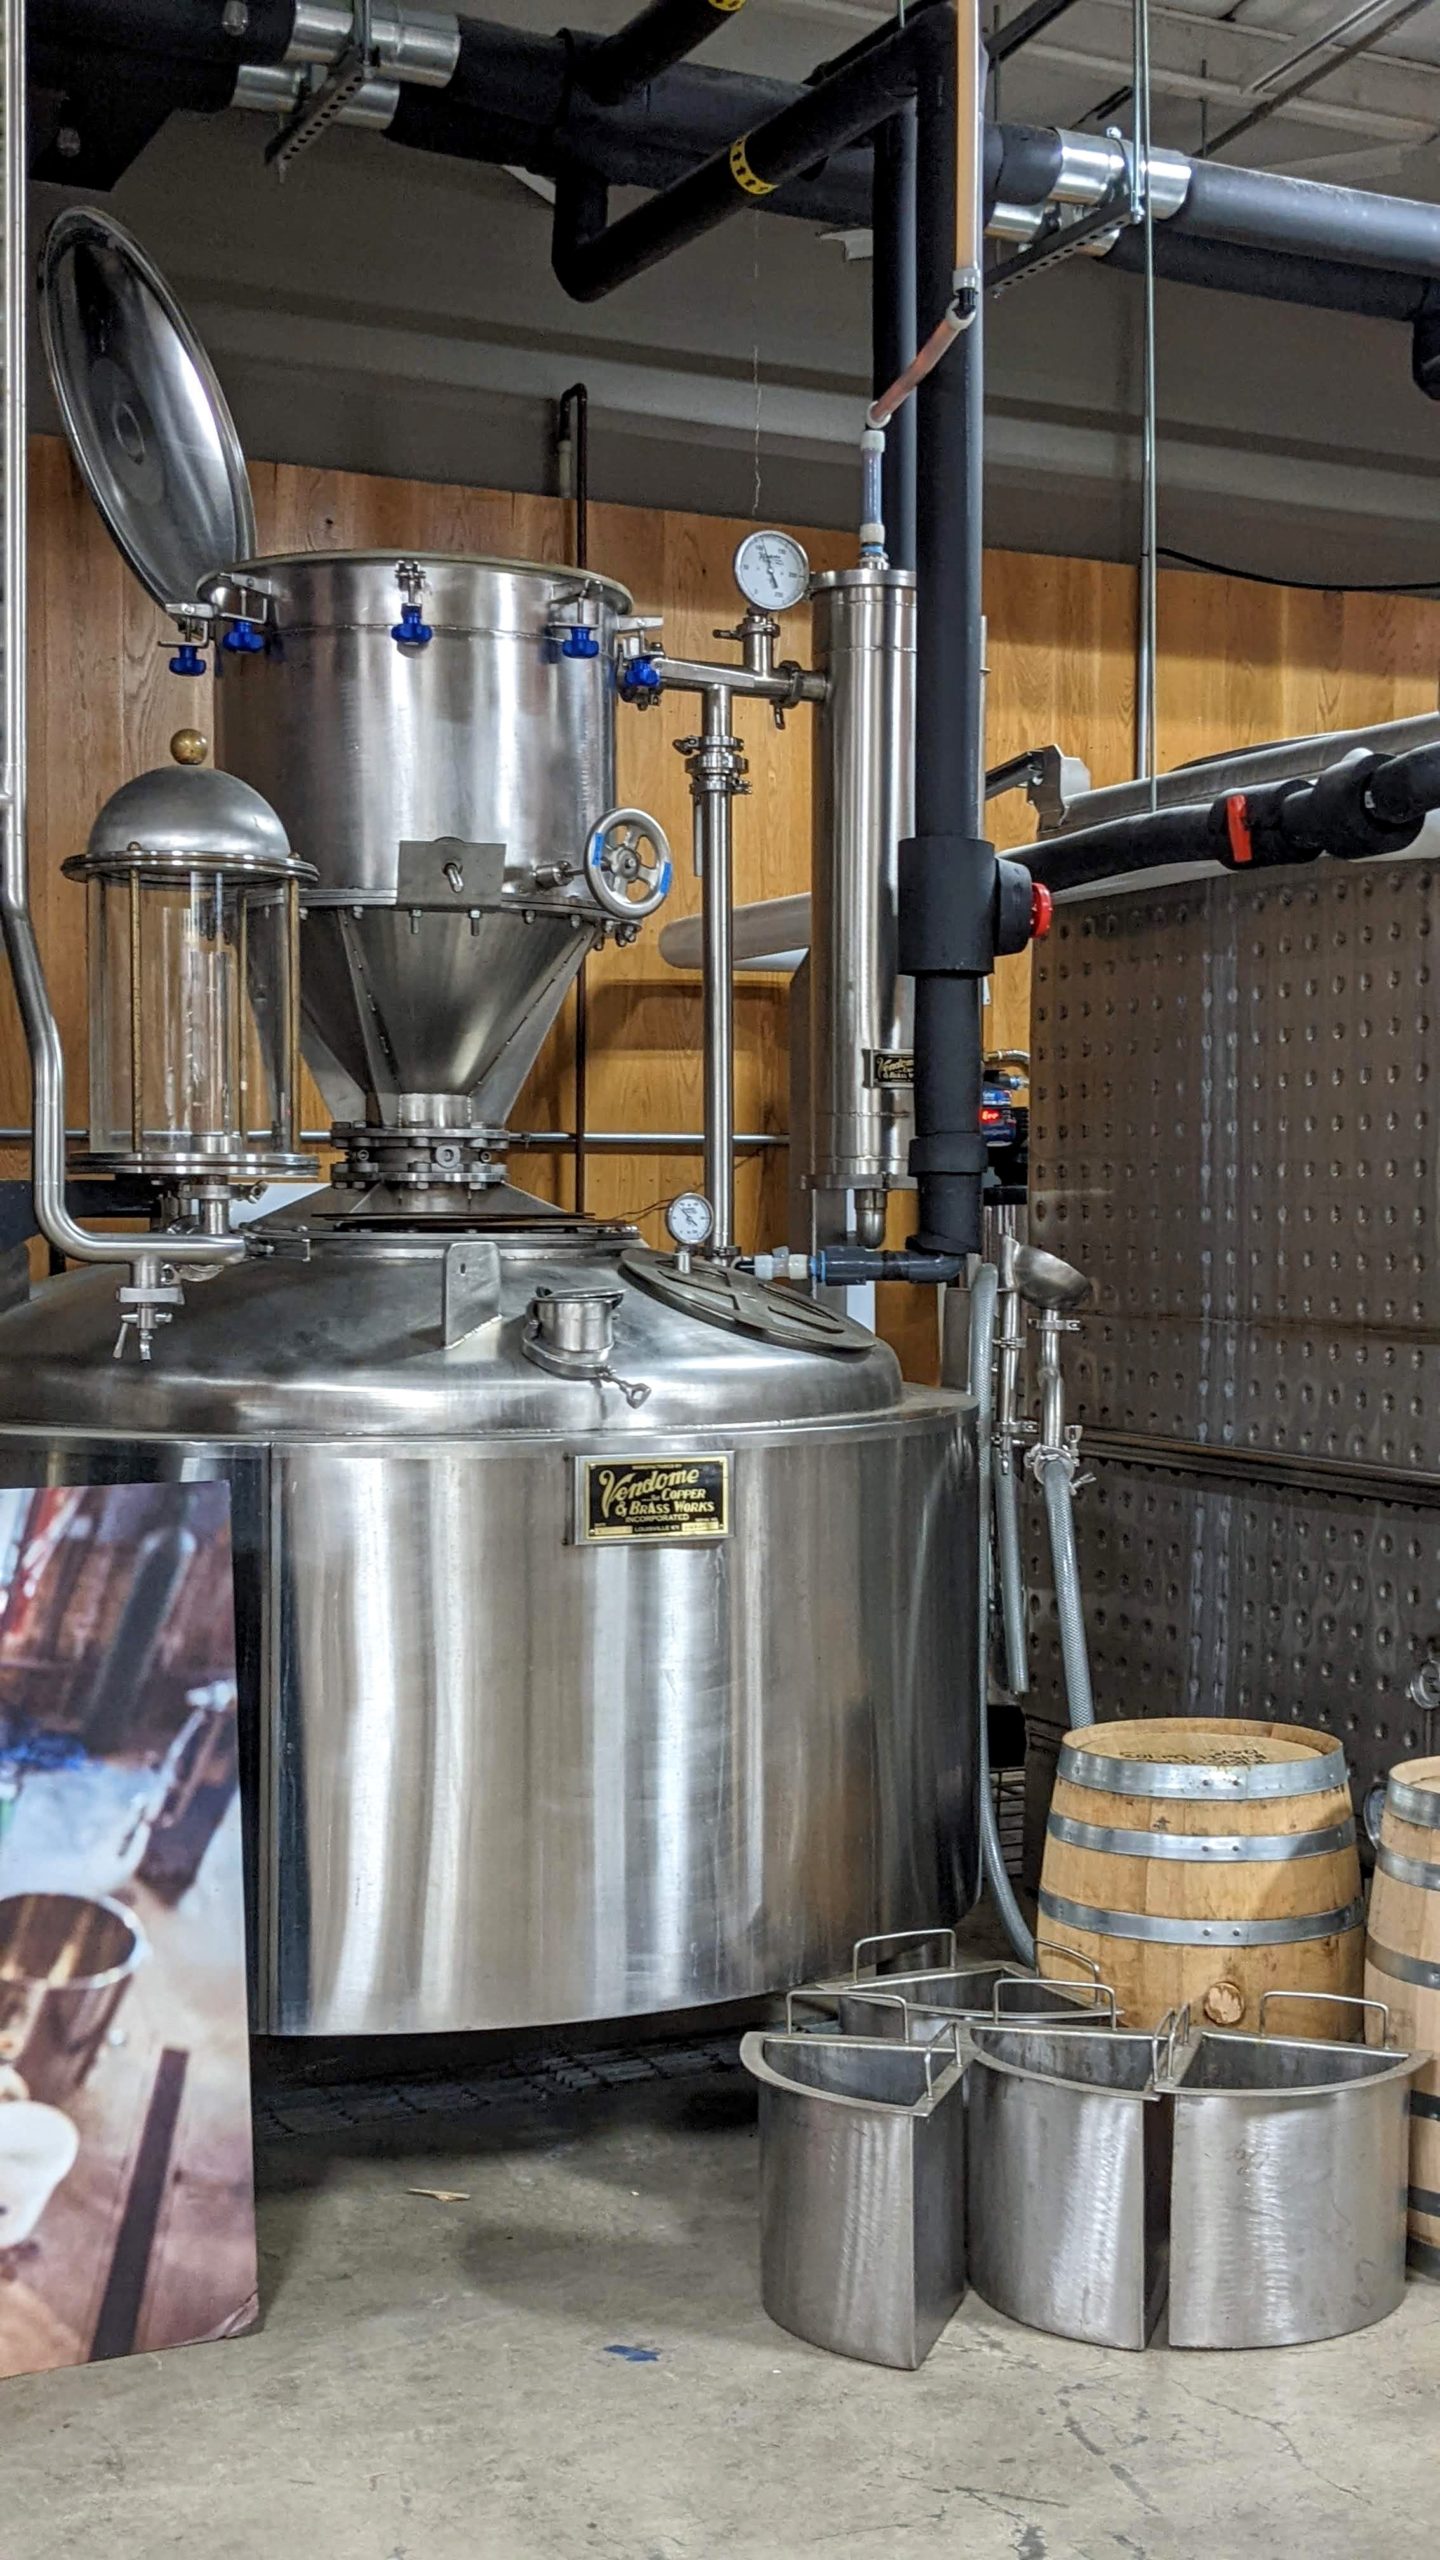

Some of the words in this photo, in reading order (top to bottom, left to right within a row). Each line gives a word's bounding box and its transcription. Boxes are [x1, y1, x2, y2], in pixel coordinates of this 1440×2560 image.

[876, 1057, 914, 1079] Vendom
[599, 1469, 699, 1518] Vendome
[661, 1488, 706, 1501] COPPER
[615, 1501, 628, 1518] &
[630, 1501, 670, 1514] BRASS
[674, 1500, 715, 1513] WORKS
[625, 1513, 690, 1523] INCORPORATED
